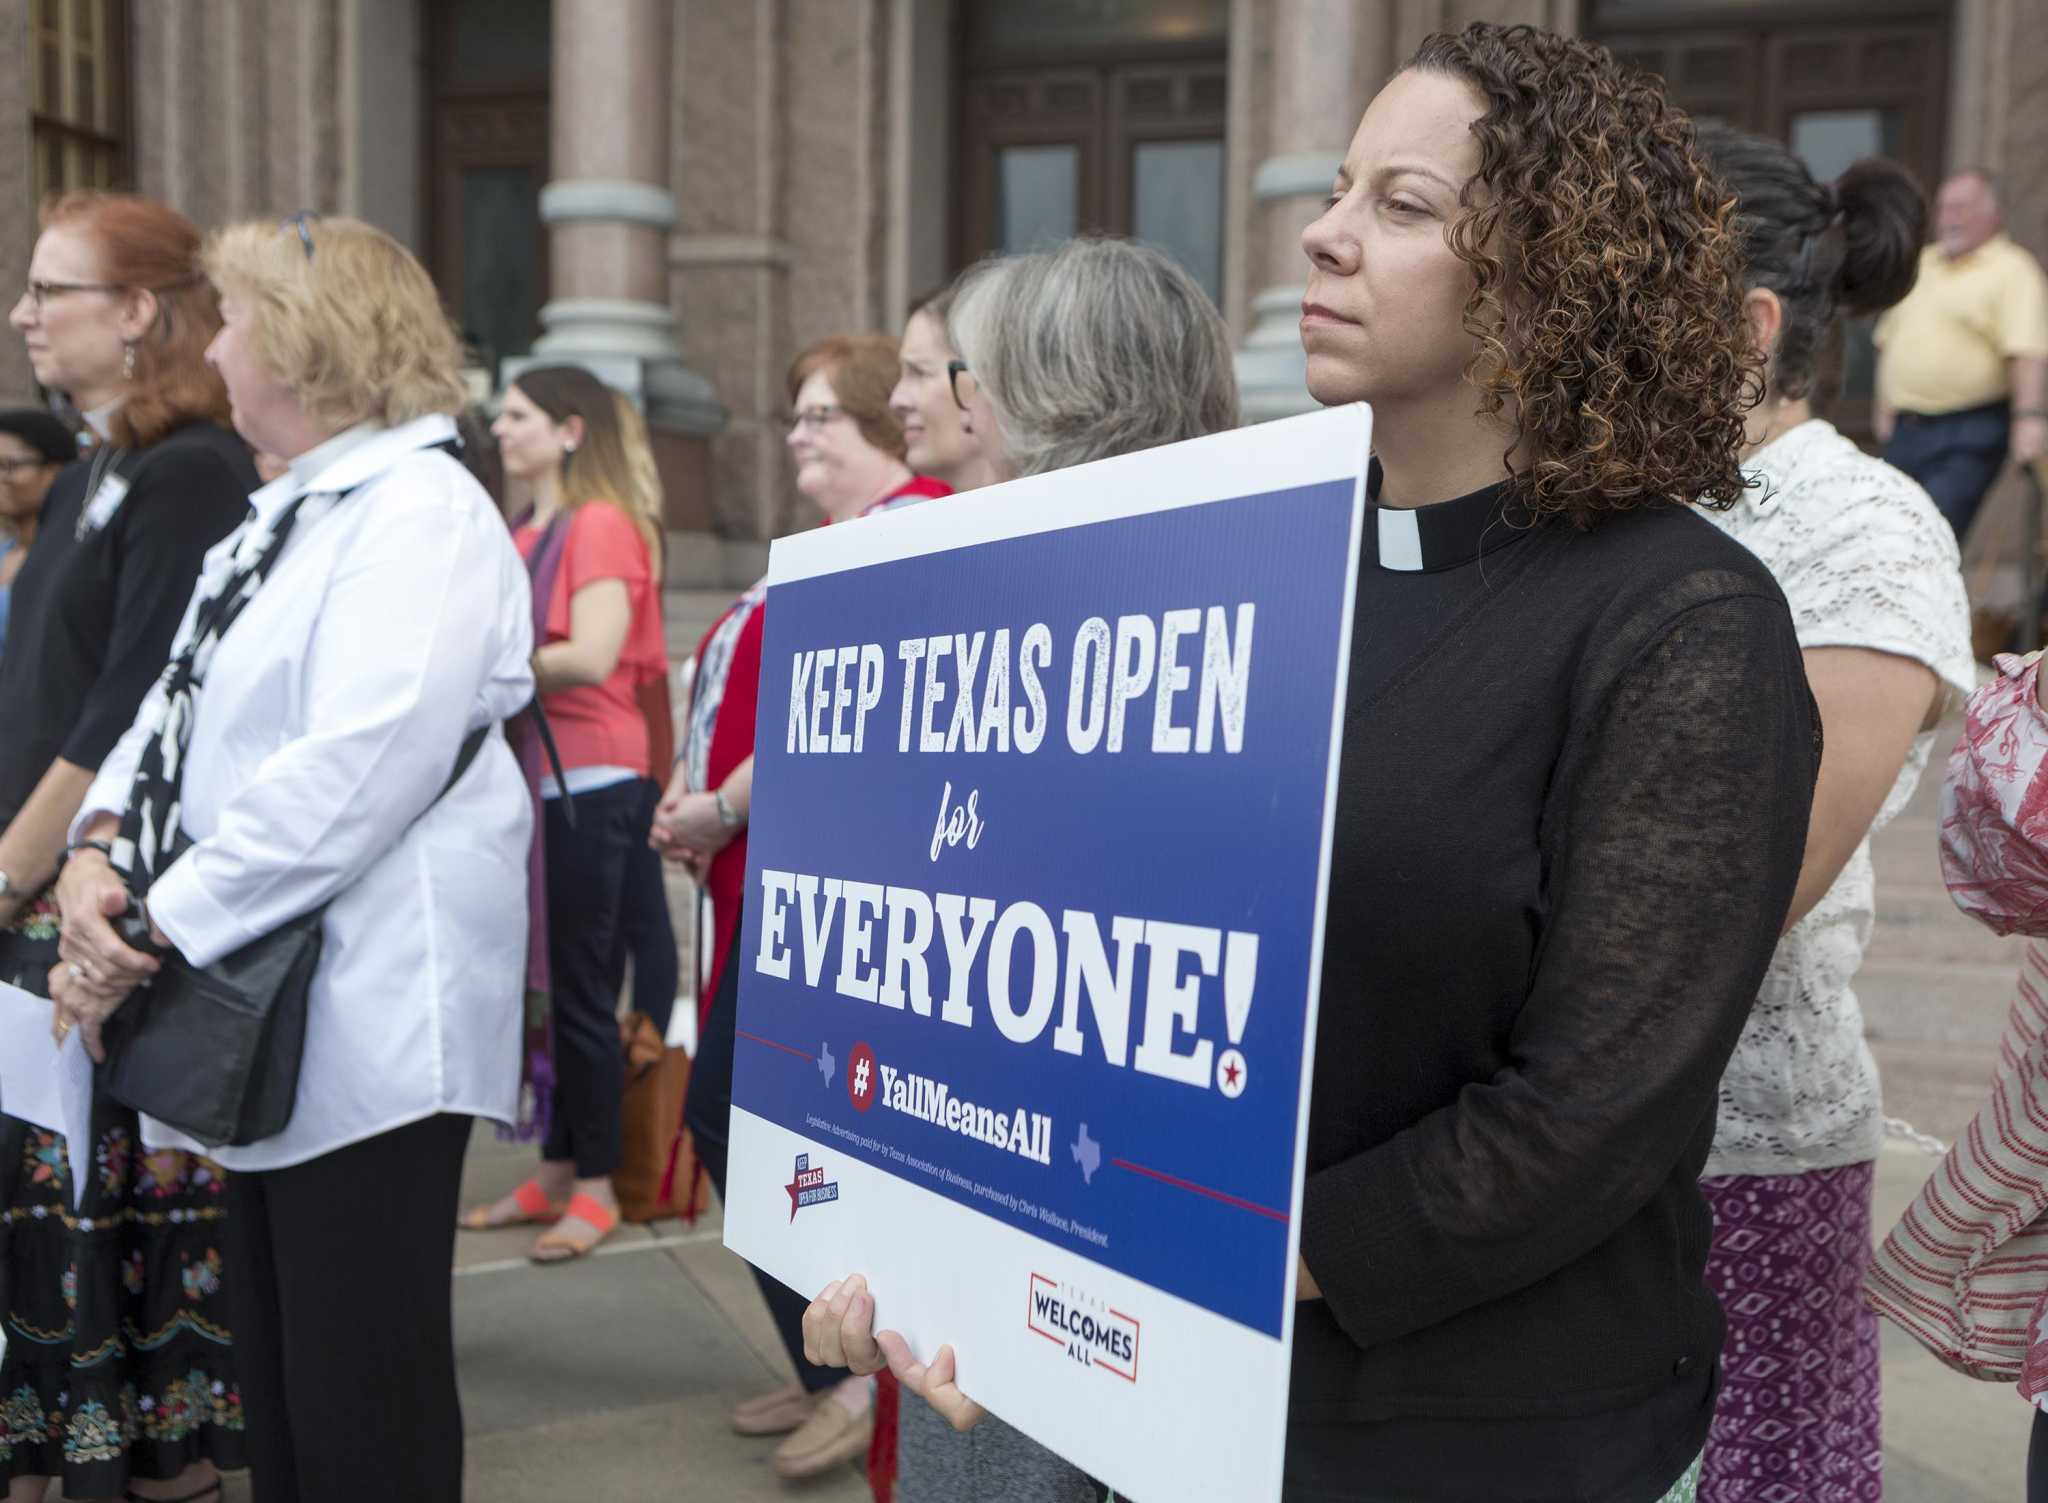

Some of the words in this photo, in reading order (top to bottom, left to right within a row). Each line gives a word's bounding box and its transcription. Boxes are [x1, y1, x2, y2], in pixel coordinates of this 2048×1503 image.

[787, 644, 884, 754] KEEP
[898, 623, 1053, 754] TEXAS
[1066, 602, 1256, 754] OPEN
[930, 781, 984, 861] for
[755, 869, 1260, 1099] EVERYONE!
[797, 1170, 822, 1188] TEXAS
[805, 1112, 832, 1133] Legislative
[831, 1123, 860, 1145] Advertising
[860, 1136, 873, 1149] paid
[871, 1138, 882, 1152] for
[881, 1143, 889, 1156] by
[889, 1146, 906, 1162] Texas
[905, 1153, 938, 1176] Association
[938, 1167, 946, 1181] of
[973, 1183, 1009, 1206] purchased
[1009, 1193, 1018, 1212] by
[1018, 1199, 1038, 1219] Chris
[1035, 1290, 1132, 1362] WELCOMES
[1067, 1343, 1091, 1367] ALL
